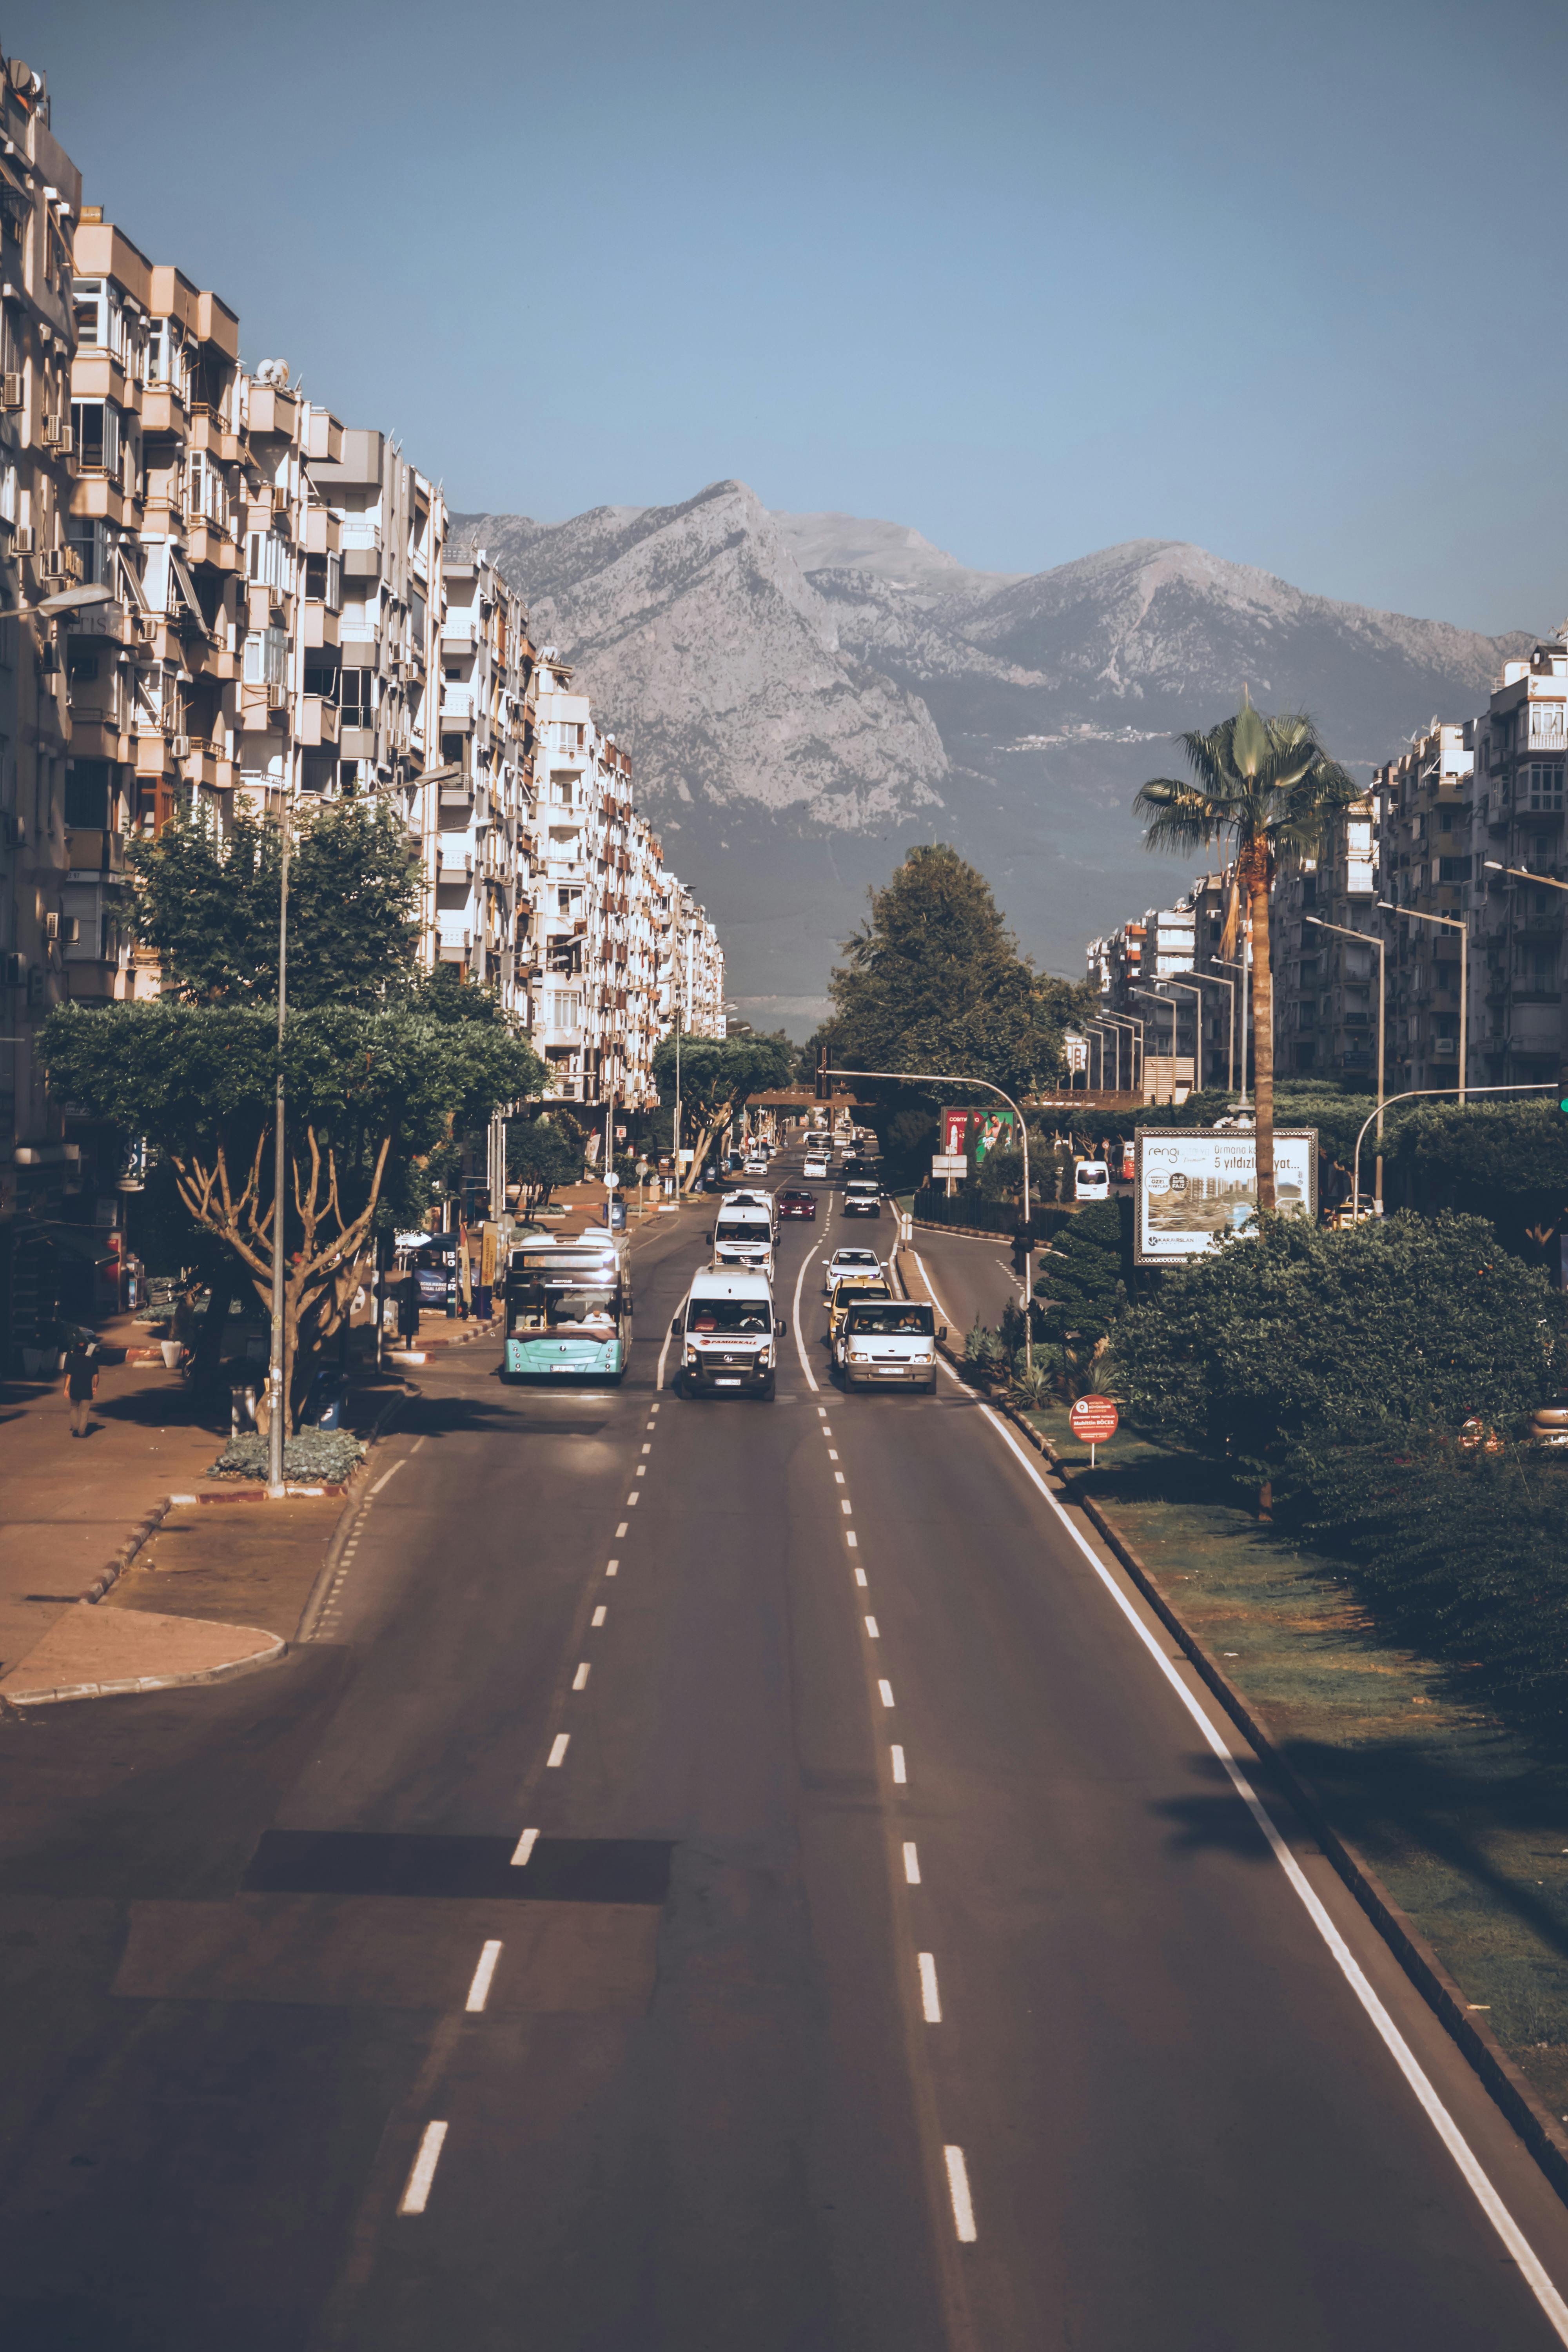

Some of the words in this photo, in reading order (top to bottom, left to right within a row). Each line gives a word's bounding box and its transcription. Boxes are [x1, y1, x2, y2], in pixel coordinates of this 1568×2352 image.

[1214, 1145, 1246, 1154] Ormana
[1214, 1157, 1220, 1168] 5
[1224, 1157, 1257, 1171] yıldızl
[1274, 1159, 1300, 1171] yat...
